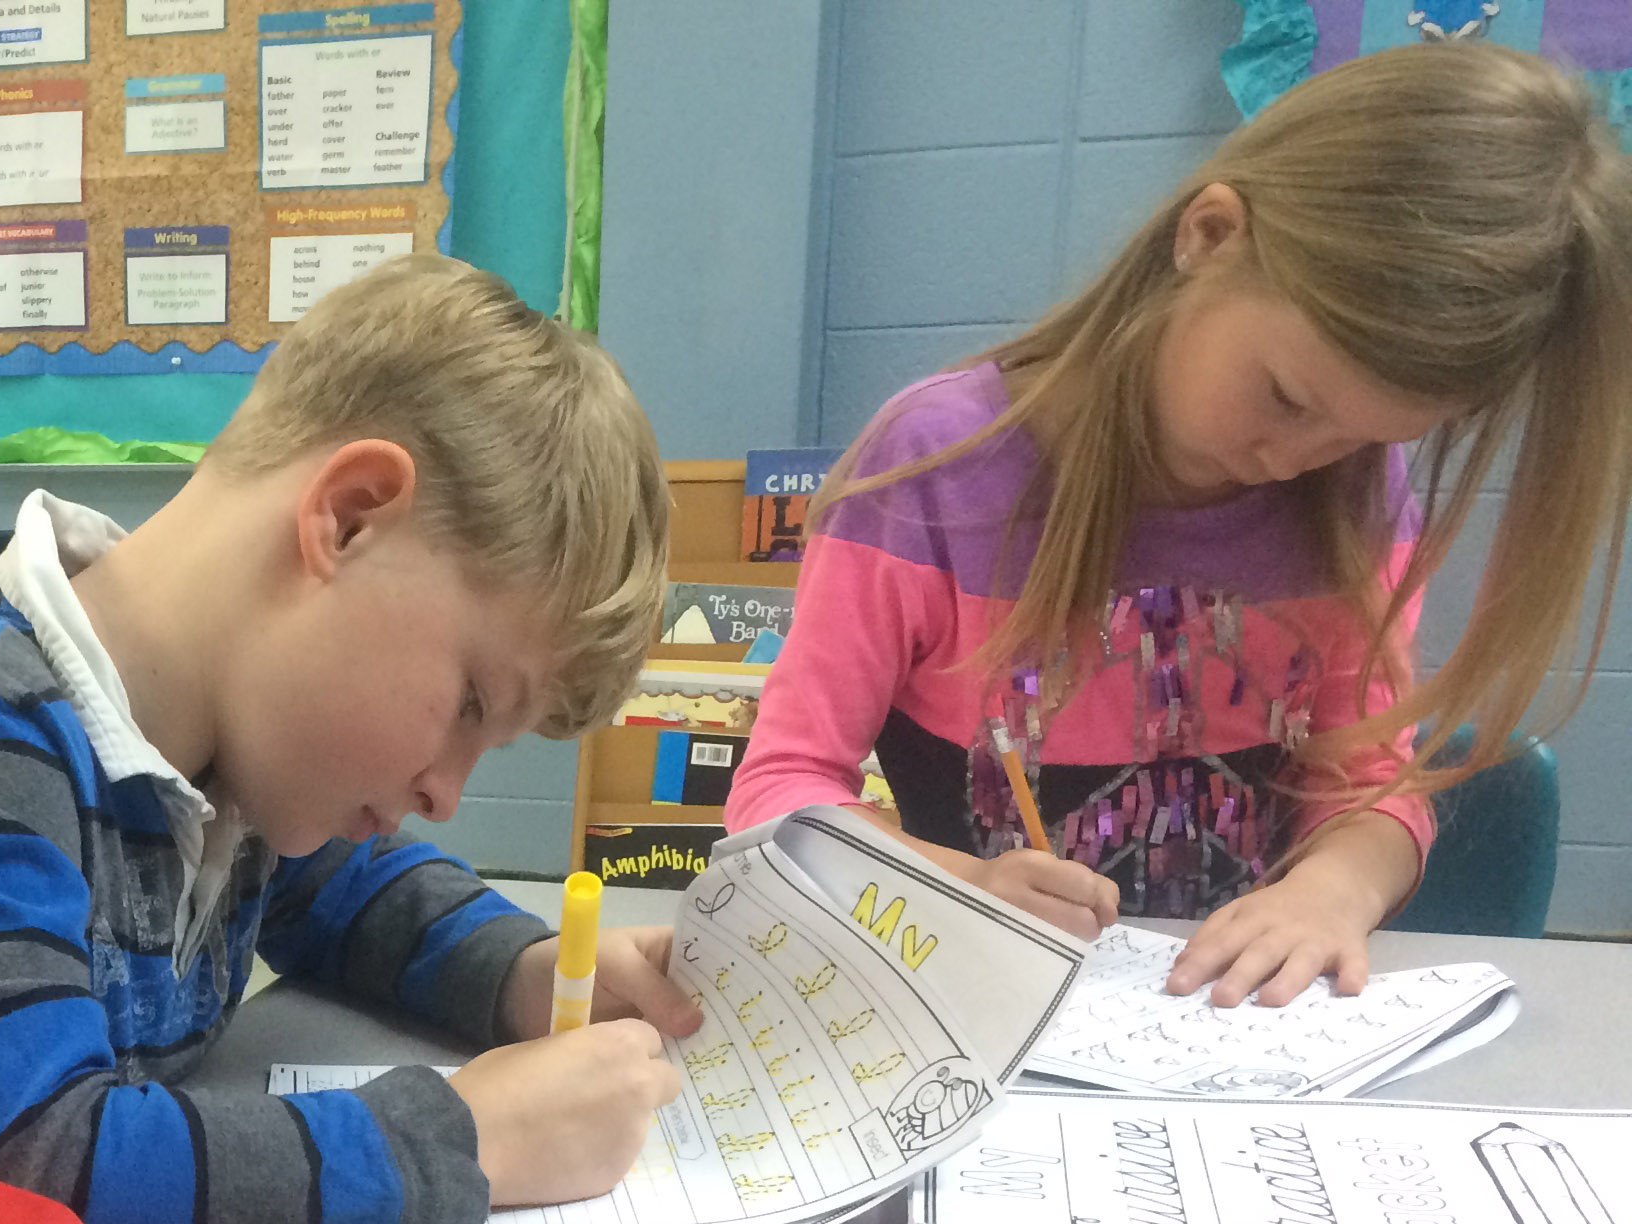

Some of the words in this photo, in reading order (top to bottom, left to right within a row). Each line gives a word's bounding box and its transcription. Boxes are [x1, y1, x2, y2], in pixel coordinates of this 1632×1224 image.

[7, 6, 26, 16] and
[28, 4, 61, 15] Details
[376, 69, 411, 78] Review
[267, 76, 292, 85] Basic
[267, 91, 294, 101] father
[268, 108, 287, 116] over
[322, 103, 352, 113] cracker
[268, 122, 294, 132] under
[322, 119, 343, 129] offer
[322, 136, 346, 144] cover
[375, 131, 420, 142] Challenge
[268, 138, 288, 147] herd
[374, 147, 416, 157] remember
[268, 153, 294, 162] water
[267, 168, 287, 177] verb
[321, 166, 351, 175] master
[373, 163, 403, 172] feather
[276, 208, 367, 224] High-Frequency
[370, 205, 406, 218] Words
[154, 231, 197, 246] Writing
[352, 243, 385, 254] nothing
[293, 259, 320, 269] behind
[20, 268, 58, 277] otherwise
[292, 275, 316, 284] house
[21, 282, 45, 293] junior
[292, 290, 309, 299] how
[21, 296, 52, 306] slippery
[22, 309, 48, 320] finally
[709, 594, 740, 620] Ty's
[729, 621, 779, 643] Bad
[601, 844, 711, 881] Amphibia
[960, 1147, 1062, 1200] My
